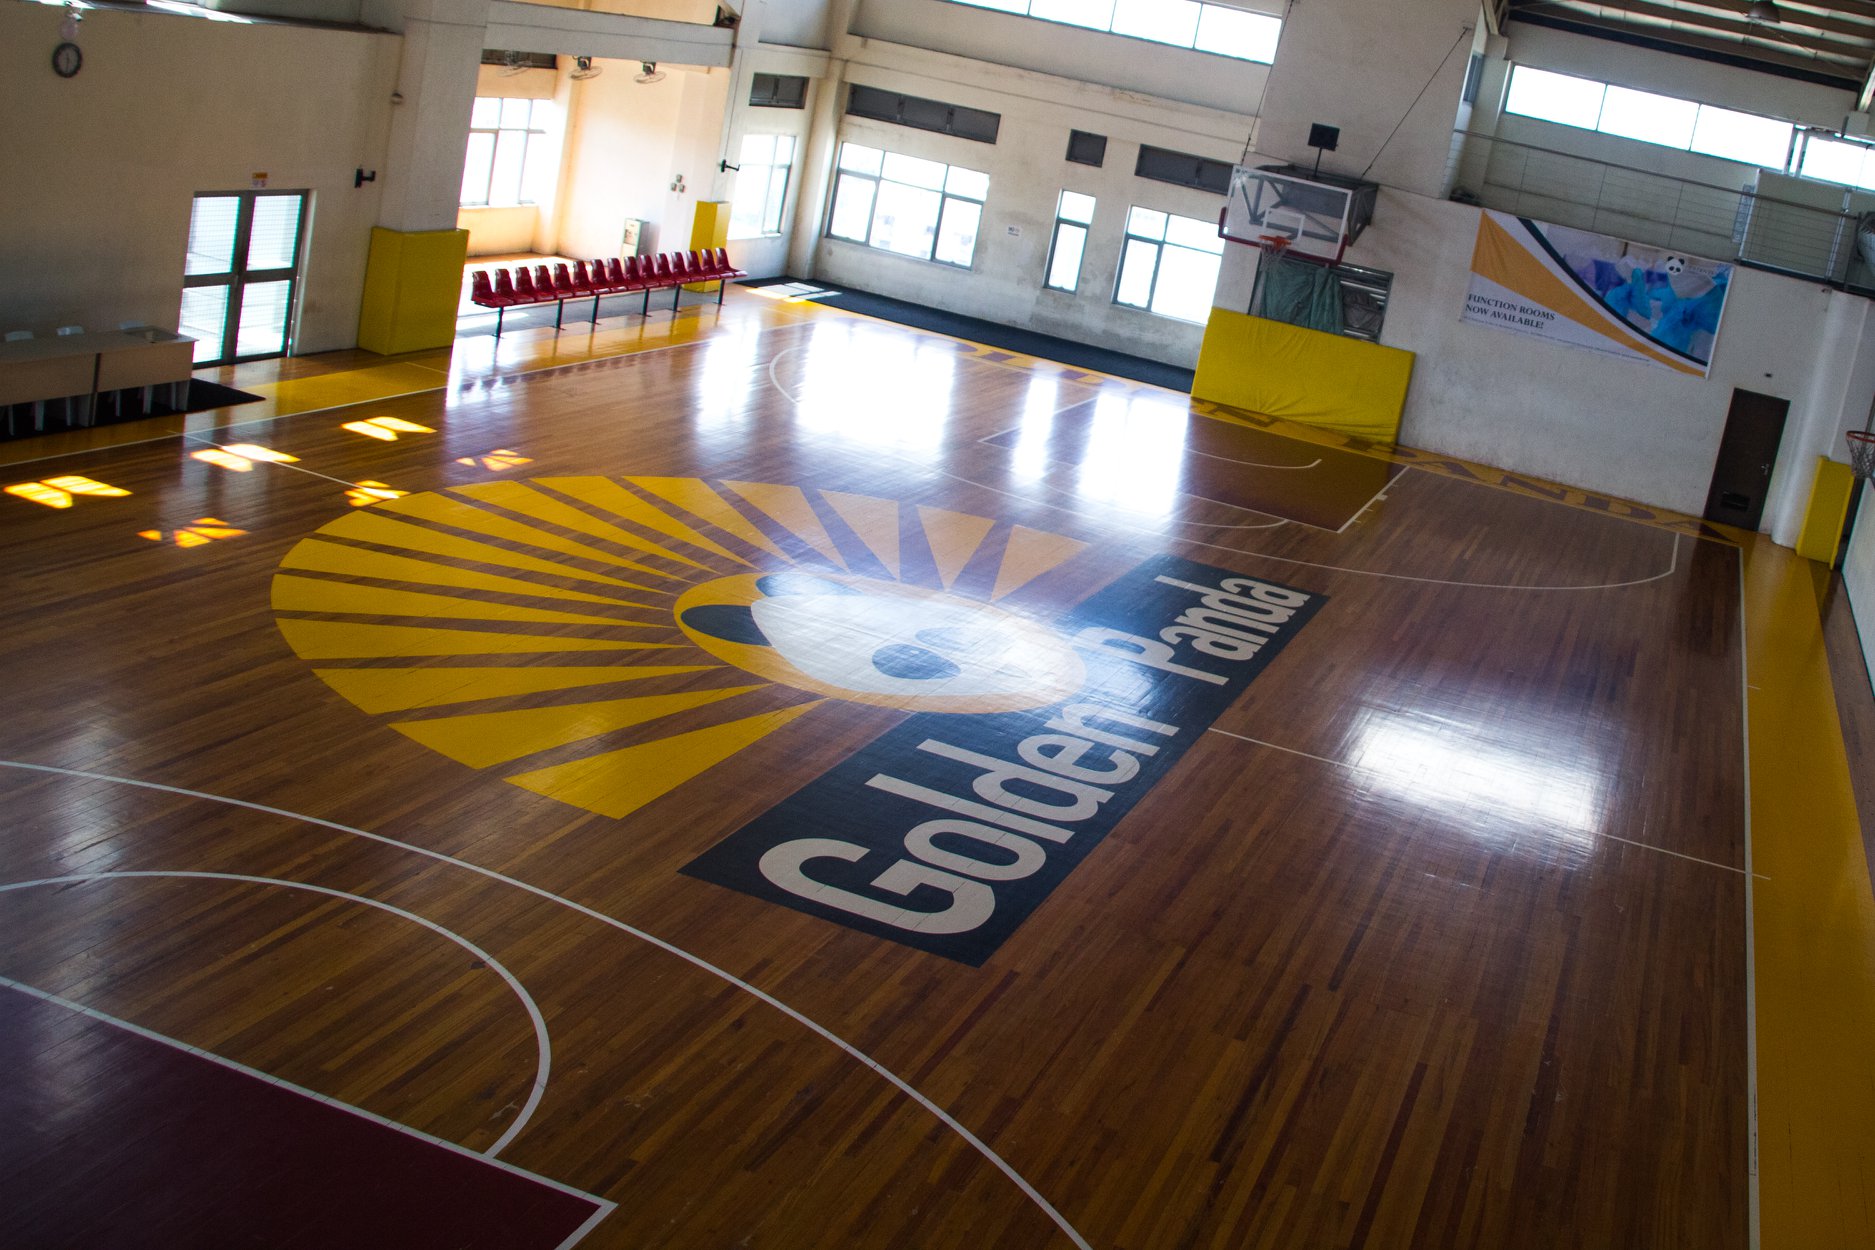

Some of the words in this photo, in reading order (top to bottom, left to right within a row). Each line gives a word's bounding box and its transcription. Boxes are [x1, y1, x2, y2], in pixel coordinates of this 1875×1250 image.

[1465, 303, 1490, 315] NOW
[1490, 310, 1545, 329] AVAILABLE!
[1467, 293, 1518, 311] FUNCTION
[1519, 305, 1556, 320] ROOMS
[758, 702, 1181, 934] Golden
[1070, 575, 1312, 686] Panda
